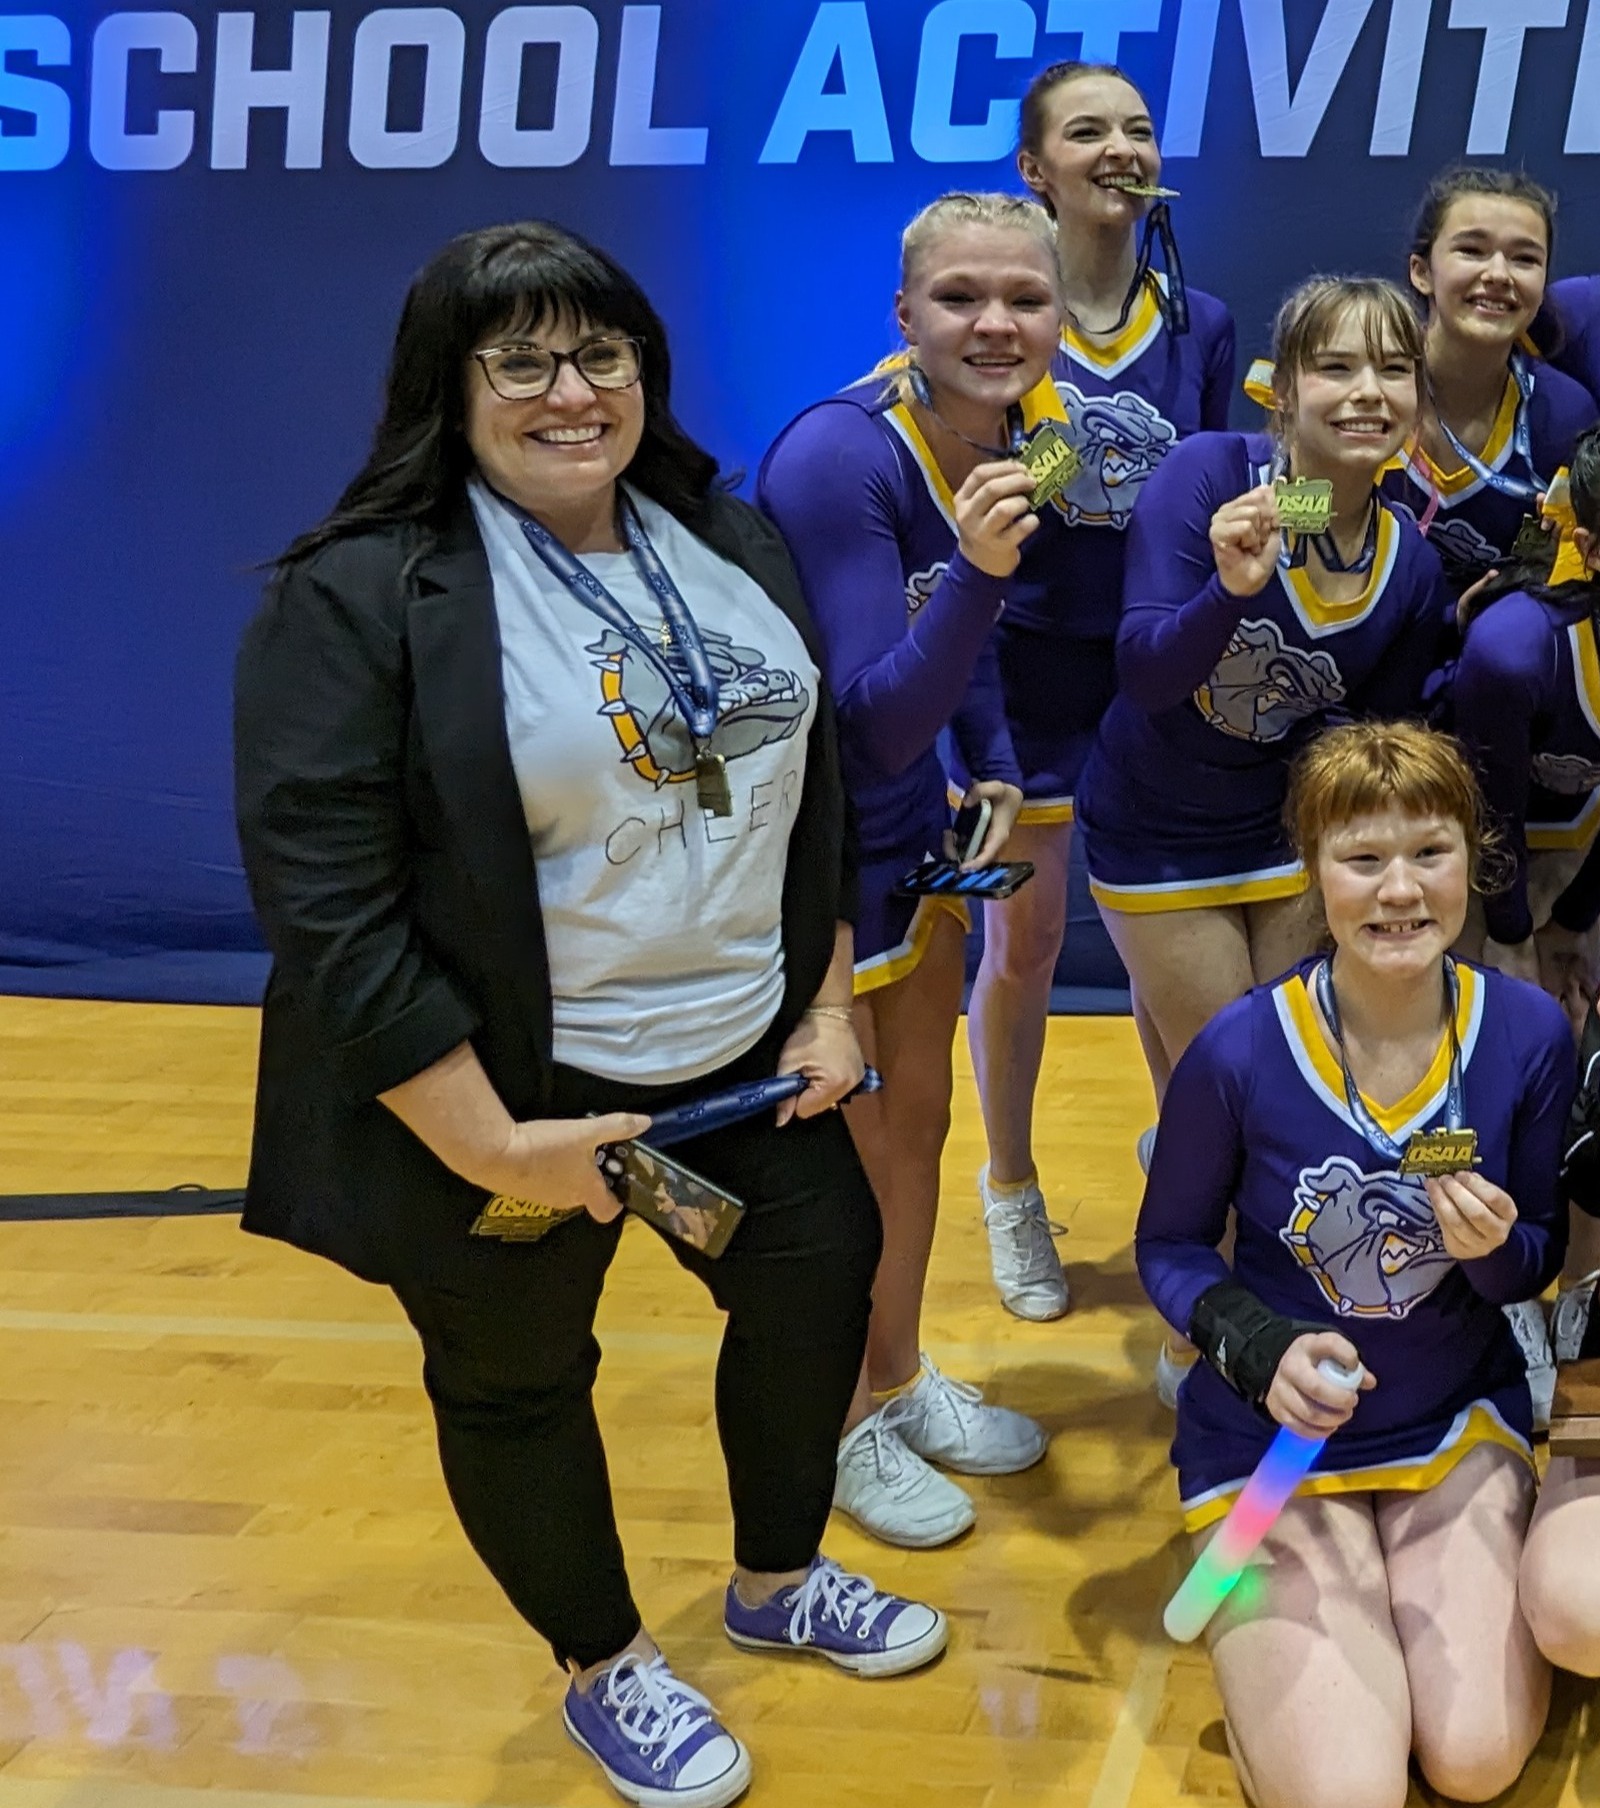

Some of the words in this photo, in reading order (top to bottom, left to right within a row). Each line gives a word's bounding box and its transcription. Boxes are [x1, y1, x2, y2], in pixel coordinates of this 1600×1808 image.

[0, 5, 709, 170] SCHOOL
[1030, 438, 1073, 485] SAA
[605, 769, 798, 866] CHEER
[1407, 1145, 1473, 1163] OSAA
